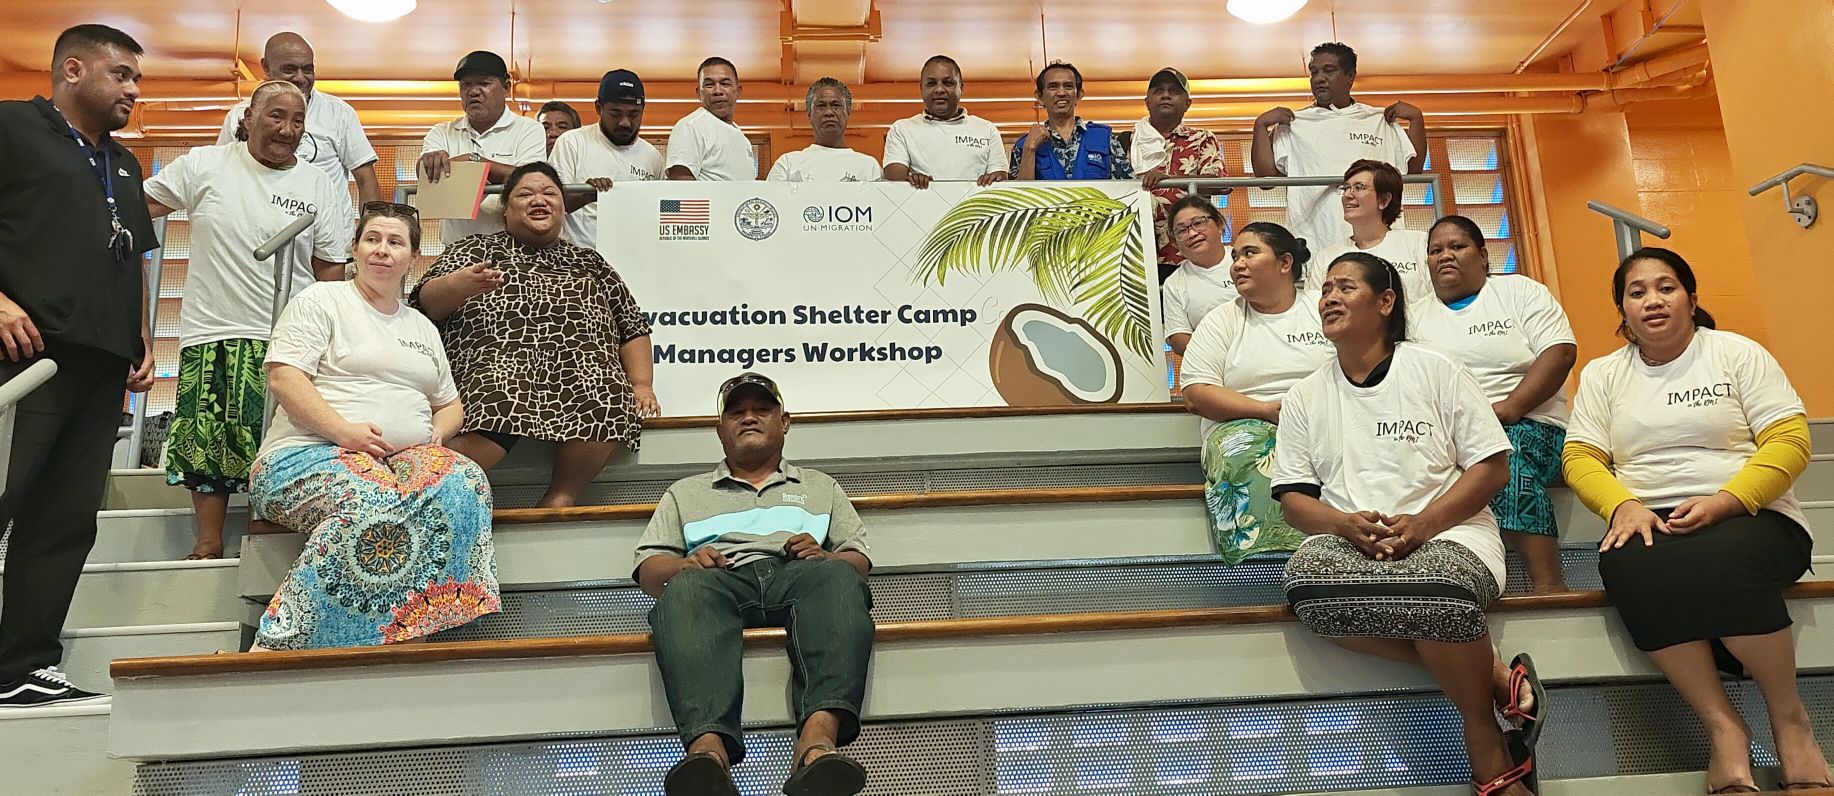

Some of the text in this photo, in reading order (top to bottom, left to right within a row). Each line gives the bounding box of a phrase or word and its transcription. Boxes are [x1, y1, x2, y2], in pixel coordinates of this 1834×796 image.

[955, 135, 990, 147] IMPACT
[1349, 132, 1383, 147] IMPACT
[270, 193, 319, 215] IMPAC
[828, 205, 872, 223] IOM
[659, 224, 710, 236] US EMBASSY
[802, 224, 873, 232] UN MIGRATION
[642, 303, 787, 326] vacuation
[793, 304, 892, 325] Shelter
[897, 304, 977, 327] Camp
[1468, 318, 1513, 336] IMPAC
[1286, 331, 1325, 343] IMPA
[653, 341, 943, 370] Managers Workshop
[1666, 382, 1732, 406] IMPACT
[1375, 419, 1434, 437] IMPACT
